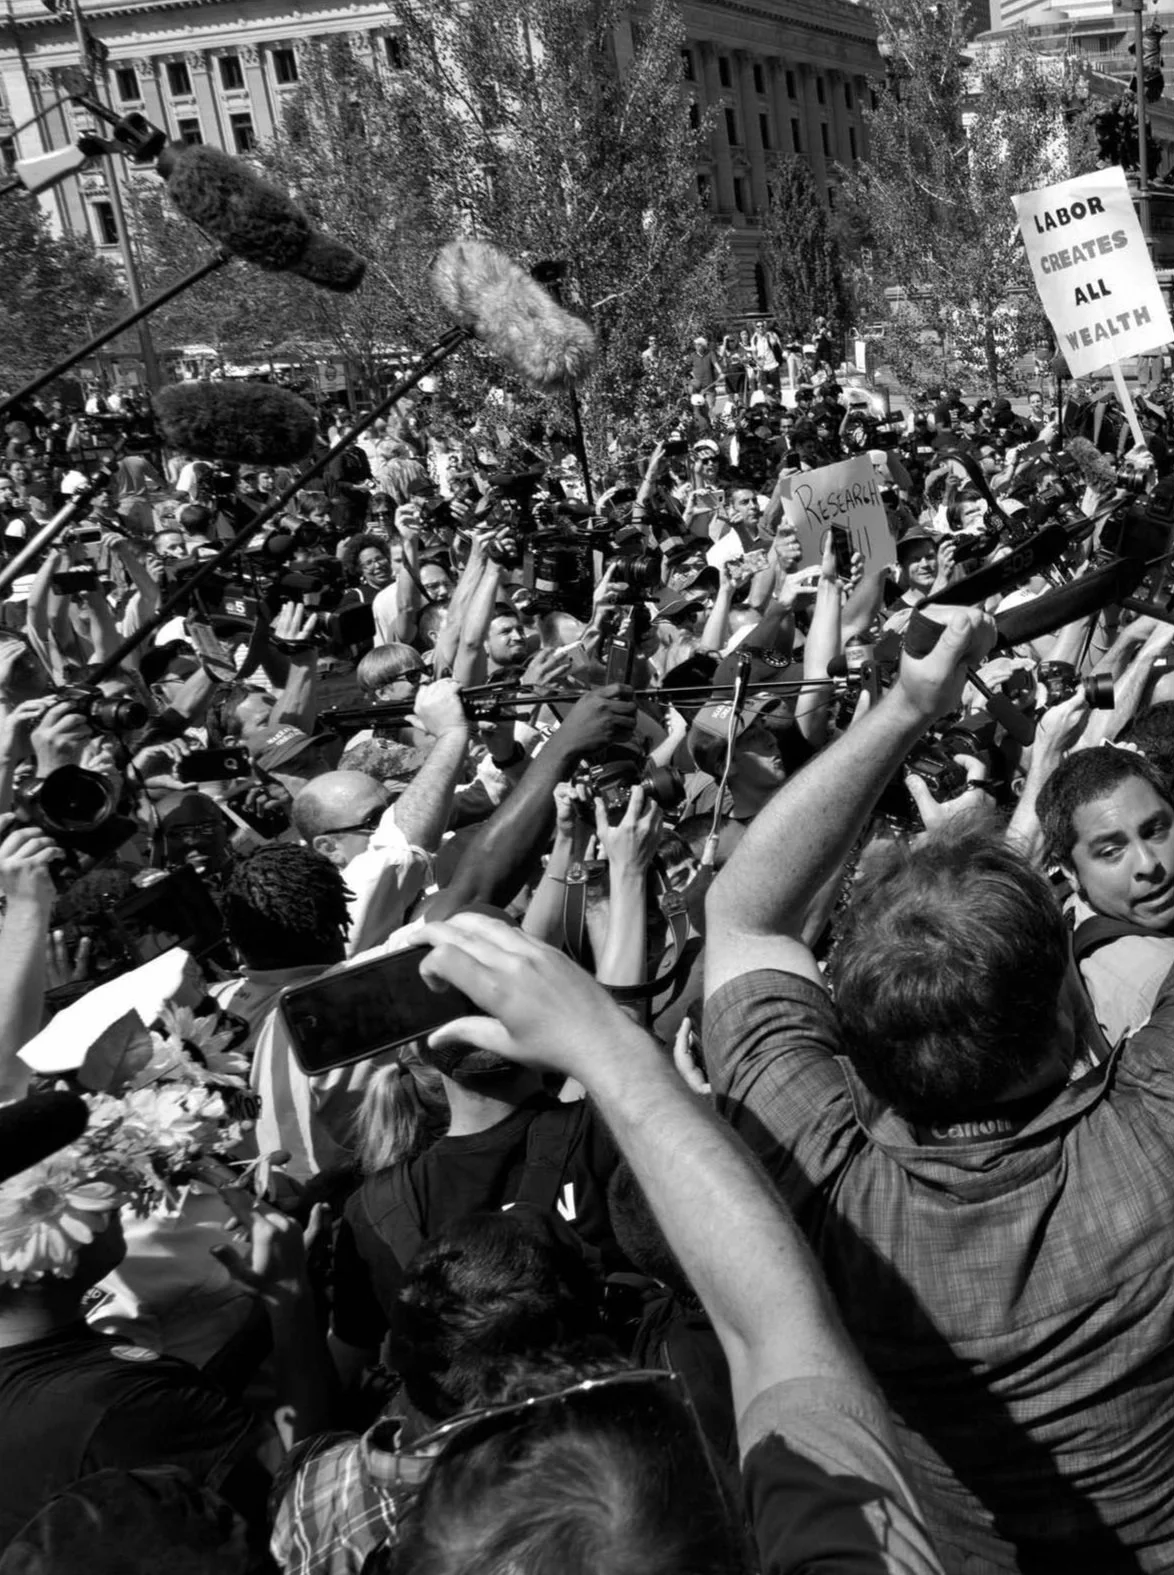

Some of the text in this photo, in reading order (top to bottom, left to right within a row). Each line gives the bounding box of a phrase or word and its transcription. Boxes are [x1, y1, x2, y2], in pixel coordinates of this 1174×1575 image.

[1033, 196, 1106, 234] LABOR
[1040, 229, 1129, 275] CREATES
[1073, 278, 1113, 306] ALL
[1065, 305, 1152, 351] WEALTH
